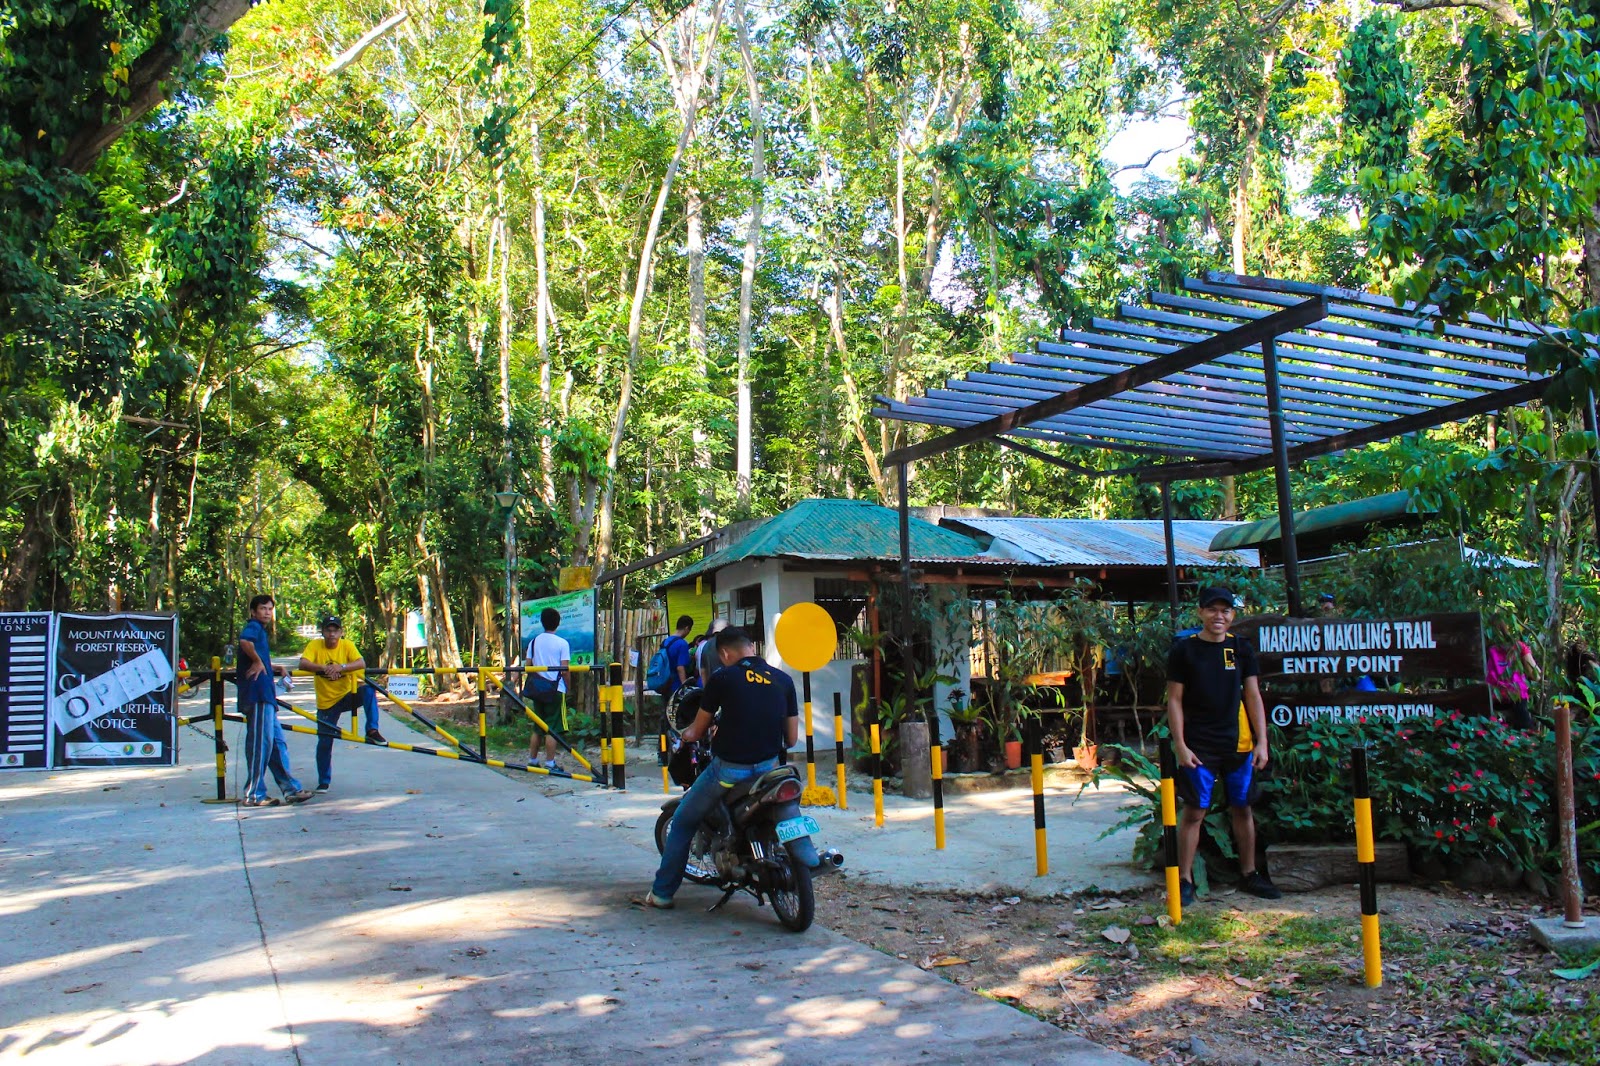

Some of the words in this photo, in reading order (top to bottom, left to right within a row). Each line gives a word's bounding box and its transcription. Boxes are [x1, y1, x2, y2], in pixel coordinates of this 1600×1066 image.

[68, 630, 112, 639] MOUNT
[112, 630, 166, 640] MAKILING
[1259, 624, 1320, 652] MARIANG
[1323, 622, 1392, 650] MAKILING
[1394, 620, 1436, 649] TRAIL
[75, 642, 114, 652] FOREST
[116, 642, 158, 652] RESERVE
[111, 660, 120, 668] IS
[1282, 656, 1341, 674] ENTRY
[1346, 656, 1404, 673] POINT
[90, 718, 137, 729] NOTICE
